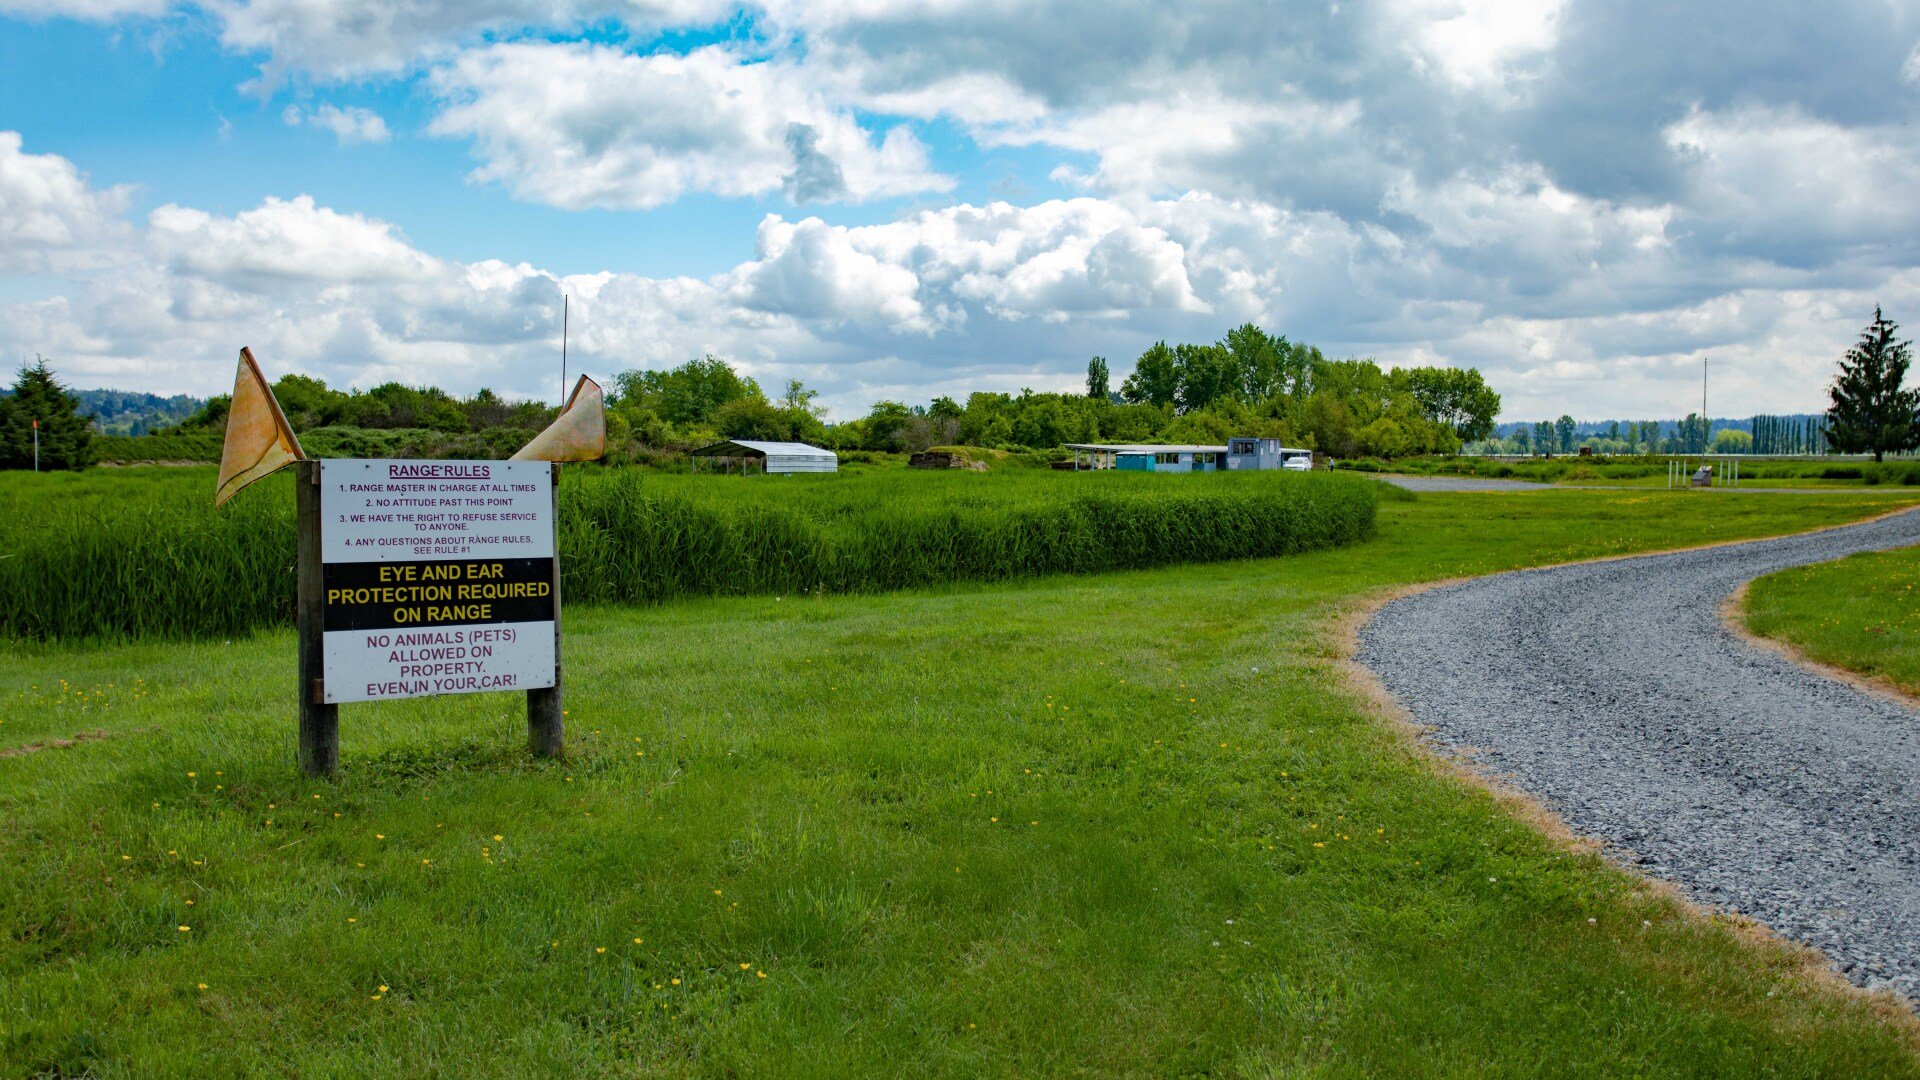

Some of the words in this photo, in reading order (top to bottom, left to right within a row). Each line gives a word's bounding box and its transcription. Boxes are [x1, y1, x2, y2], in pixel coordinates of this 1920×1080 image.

[389, 465, 439, 477] RANGE
[444, 466, 490, 476] RULES
[393, 499, 436, 507] ATTITUDE
[339, 515, 347, 523] 3.
[378, 537, 432, 546] QUESTIONS
[435, 537, 465, 545] ABOUT
[469, 536, 499, 544] RANGE
[434, 546, 458, 554] RULE
[379, 566, 416, 582] EYE
[422, 565, 461, 580] AND
[467, 564, 504, 579] EAR
[328, 586, 452, 605] PROTECTION
[458, 582, 550, 599] REQUIRED
[393, 607, 420, 623] ON
[427, 604, 492, 621] RANGE
[367, 635, 390, 648] NO
[395, 632, 464, 646] ANIMALS
[469, 629, 516, 644] (PETS)
[389, 647, 466, 663] ALLOWED
[471, 646, 492, 657] ON
[400, 661, 486, 678] PROPERTY.
[367, 681, 409, 696] EVEN
[414, 681, 428, 692] IN
[434, 677, 477, 691] YOUR
[482, 674, 517, 688] CAR!
